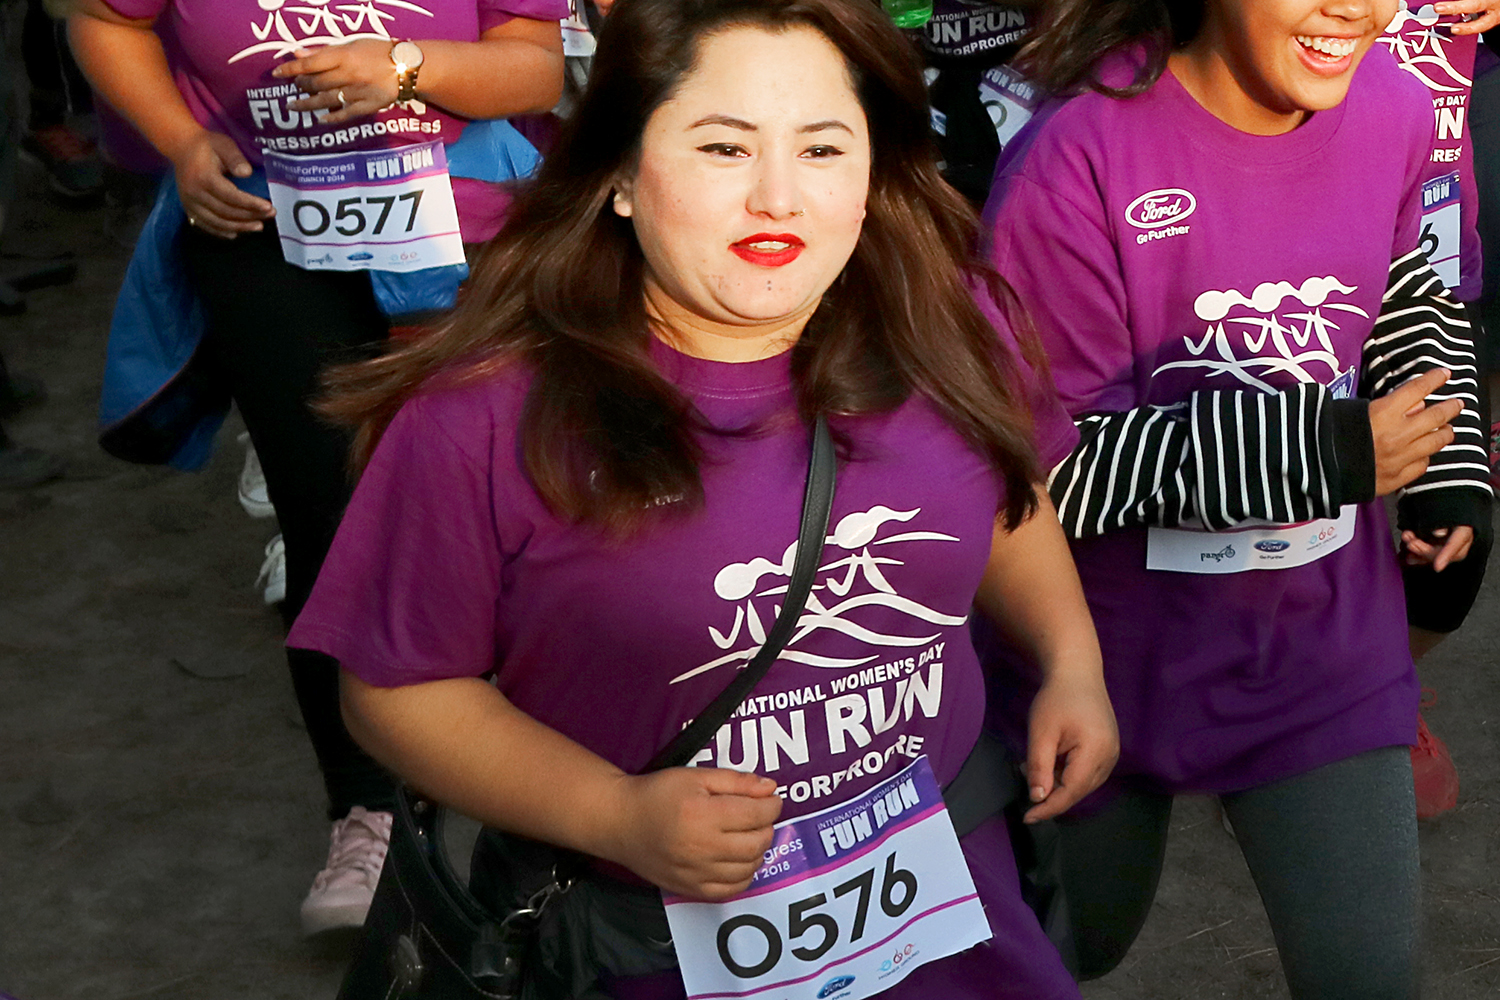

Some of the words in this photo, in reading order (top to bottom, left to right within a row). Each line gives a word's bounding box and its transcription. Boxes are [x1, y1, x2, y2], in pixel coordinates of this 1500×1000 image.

[924, 20, 962, 44] UN
[968, 9, 1026, 37] RUN
[246, 83, 299, 99] INTERNA
[1446, 94, 1467, 106] DAY
[254, 117, 441, 151] RESSFORPROGRESS
[366, 157, 401, 181] FUN
[402, 147, 434, 174] RUN
[1424, 182, 1450, 207] RUN
[292, 188, 425, 238] 0577
[1147, 225, 1190, 241] Further
[729, 683, 827, 720] NATIONAL
[830, 657, 914, 695] WOMEN'S
[917, 641, 946, 669] DAY
[824, 662, 944, 755] RUN
[817, 801, 873, 831] INTERNATIONAL
[871, 782, 901, 803] WOMEN'S
[900, 771, 913, 785] DAY
[819, 811, 874, 858] FUN
[872, 778, 921, 830] RUN
[763, 861, 791, 879] 2018
[716, 850, 919, 980] 0576
